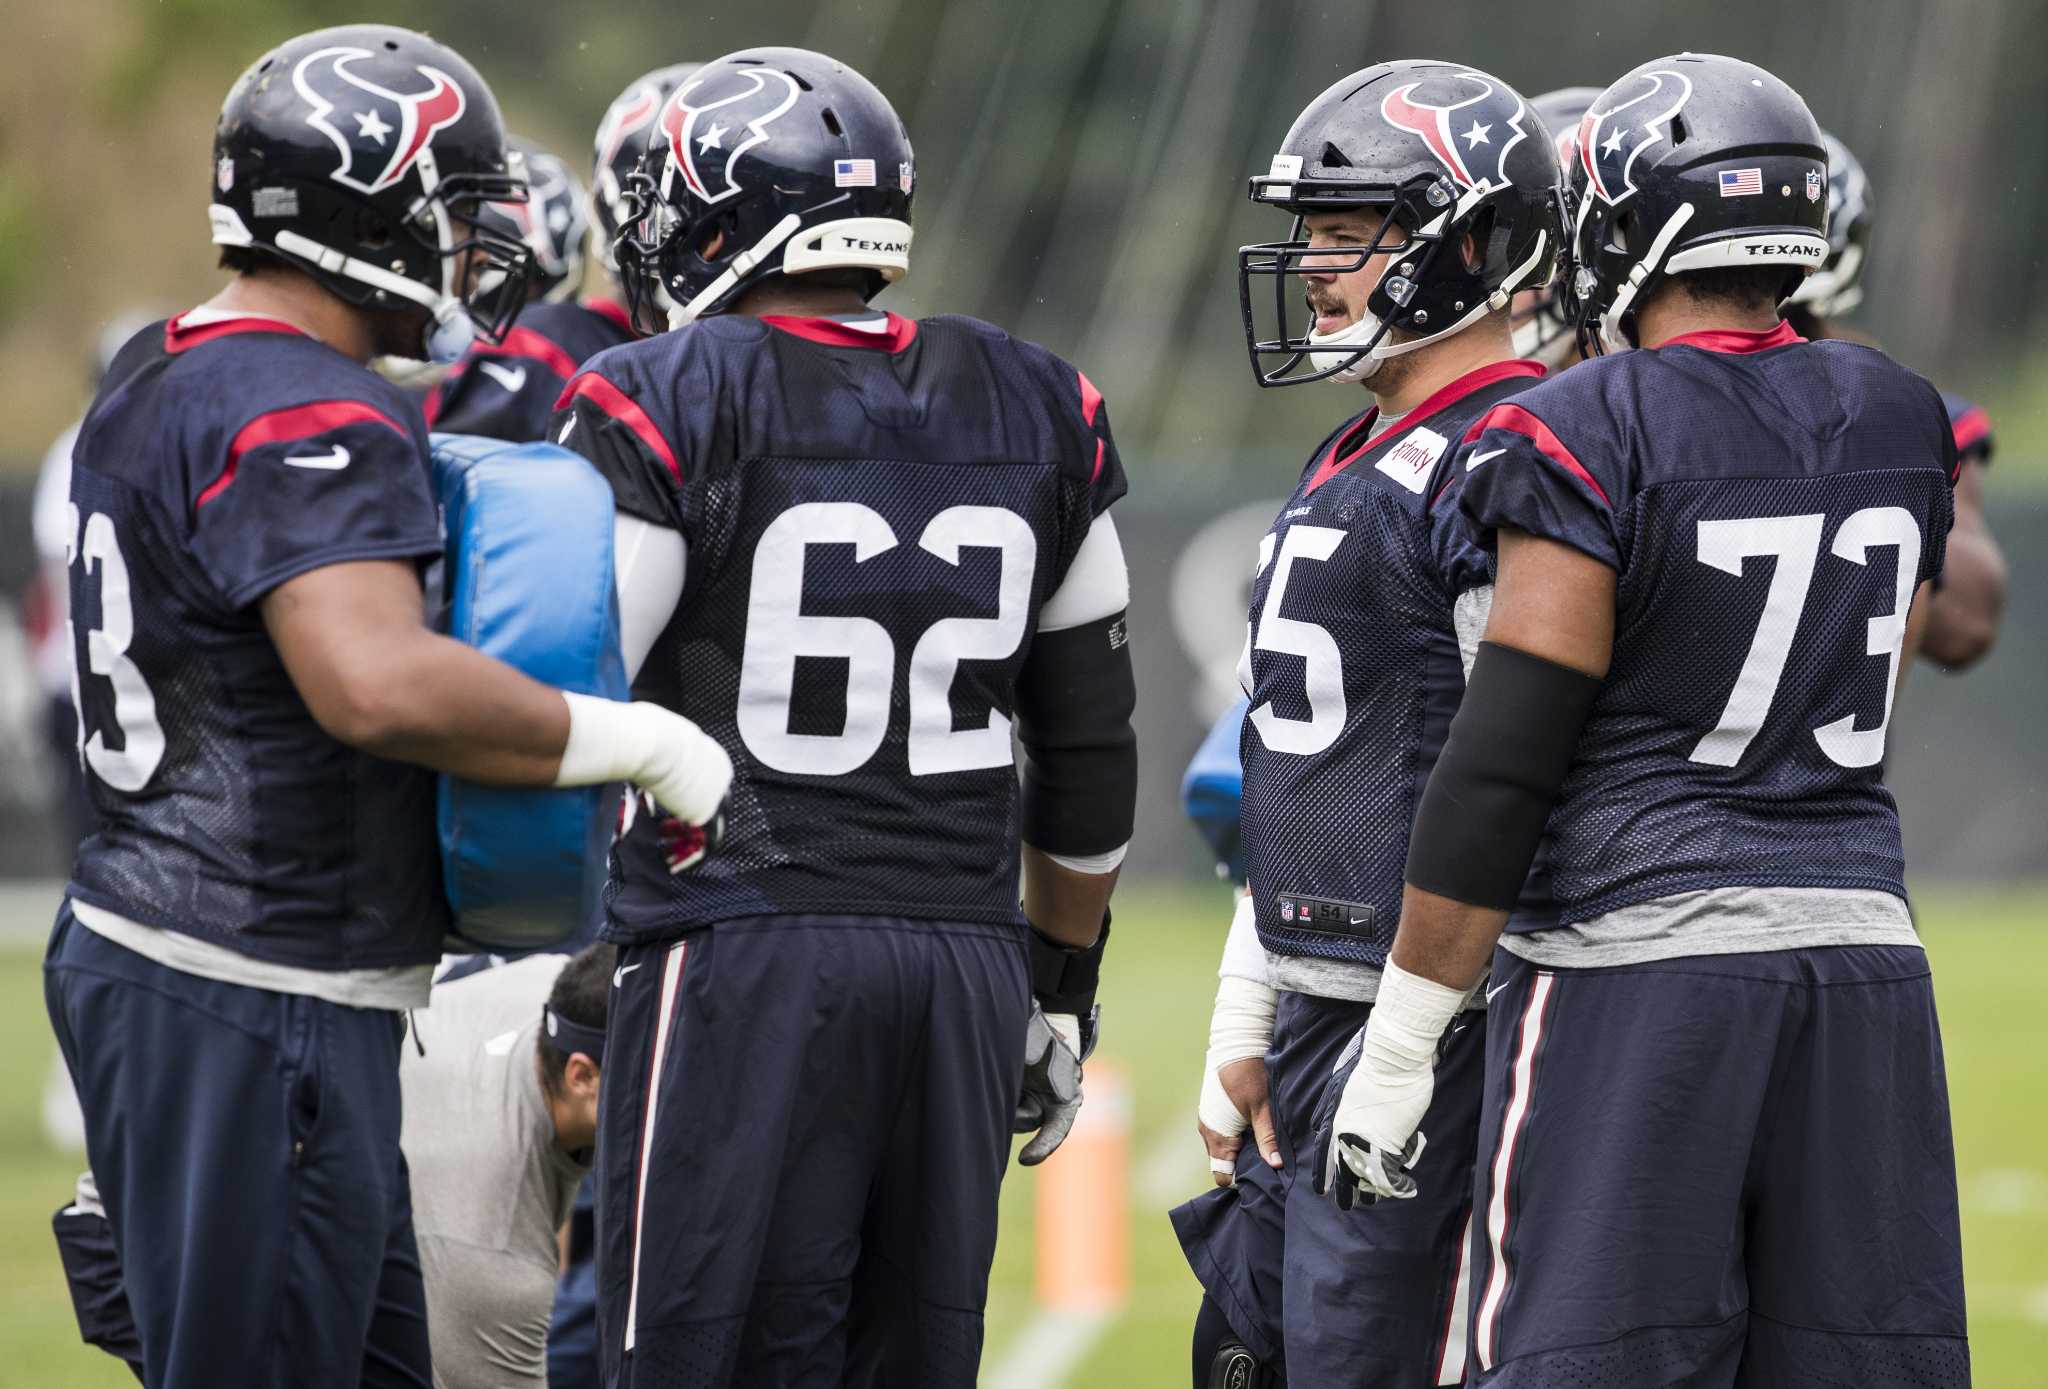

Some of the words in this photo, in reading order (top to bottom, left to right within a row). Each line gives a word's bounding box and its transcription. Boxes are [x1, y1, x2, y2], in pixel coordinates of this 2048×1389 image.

[842, 237, 909, 252] TEXANS
[1744, 244, 1821, 256] TEXANS
[66, 501, 166, 792] 3
[737, 502, 1037, 776] 62
[1687, 506, 1922, 768] 73
[1321, 904, 1340, 919] 54
